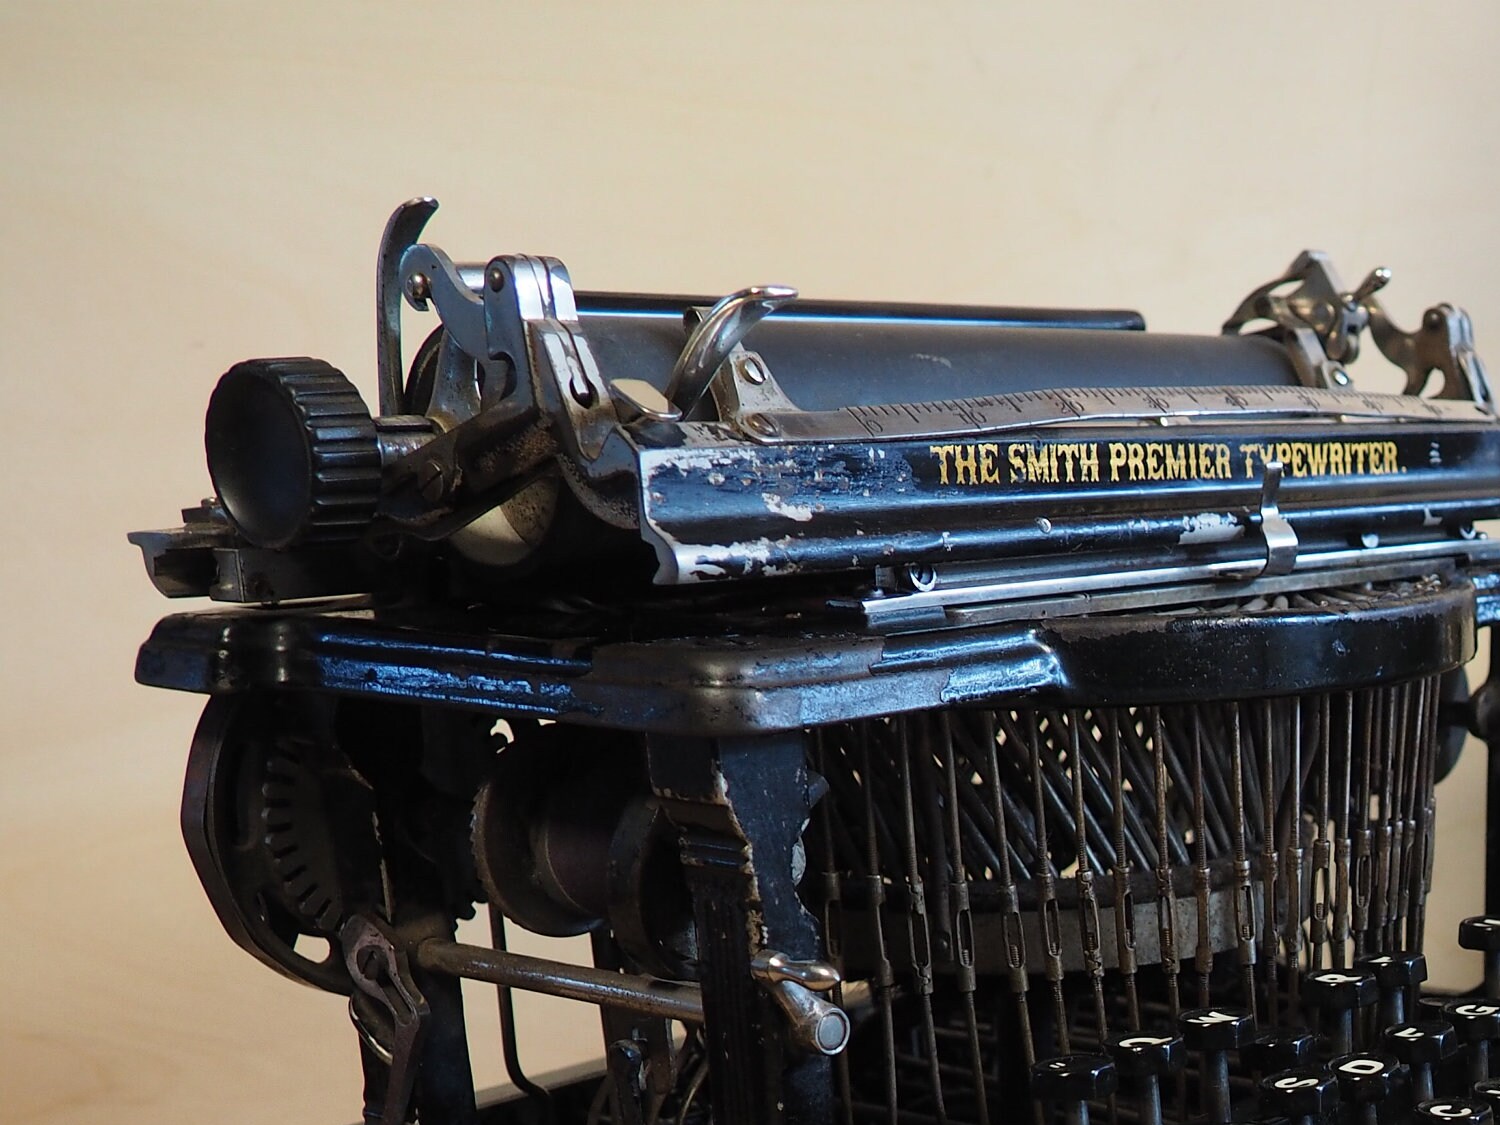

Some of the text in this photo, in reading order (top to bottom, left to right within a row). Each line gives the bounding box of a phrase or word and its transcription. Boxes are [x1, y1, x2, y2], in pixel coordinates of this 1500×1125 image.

[930, 441, 1407, 486] THE SMITH PREMIER TYPEWRITER.
[1455, 1004, 1500, 1016] G
[1186, 1011, 1239, 1024] W
[1338, 1059, 1385, 1075] D
[1274, 1077, 1319, 1089] S
[1429, 1104, 1473, 1118] C
